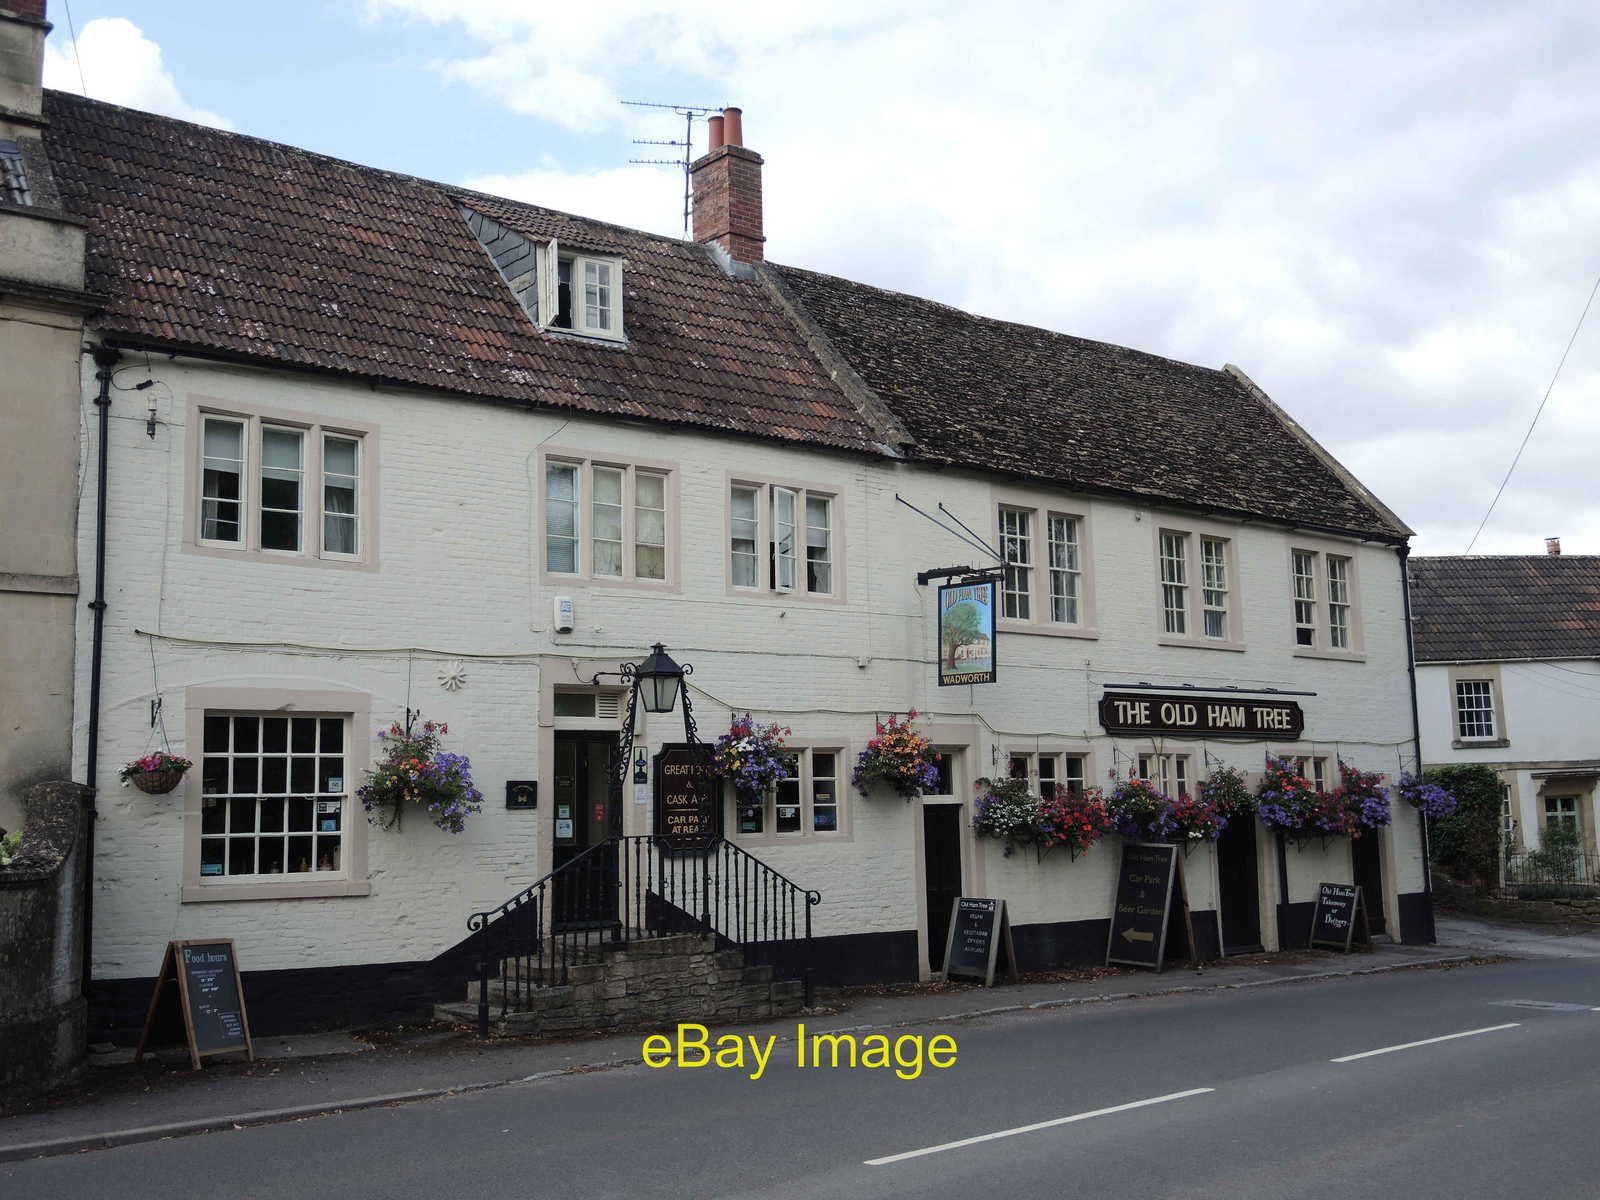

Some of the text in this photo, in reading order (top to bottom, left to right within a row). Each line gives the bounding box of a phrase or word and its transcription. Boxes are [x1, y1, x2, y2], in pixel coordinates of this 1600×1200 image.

[945, 586, 989, 611] OLD HAM TREE
[943, 673, 990, 684] WADWORTH
[1114, 701, 1291, 730] THE OLD HAM TREE
[664, 764, 690, 775] GREAT
[686, 780, 694, 789] &
[666, 794, 688, 805] CASK
[667, 815, 686, 824] CAR
[672, 825, 681, 834] AT
[1127, 853, 1168, 863] Old Ham Tree
[1129, 874, 1160, 884] Car Park
[1139, 891, 1146, 899] &
[1118, 904, 1163, 916] Beer Garden
[184, 949, 228, 964] Food hours
